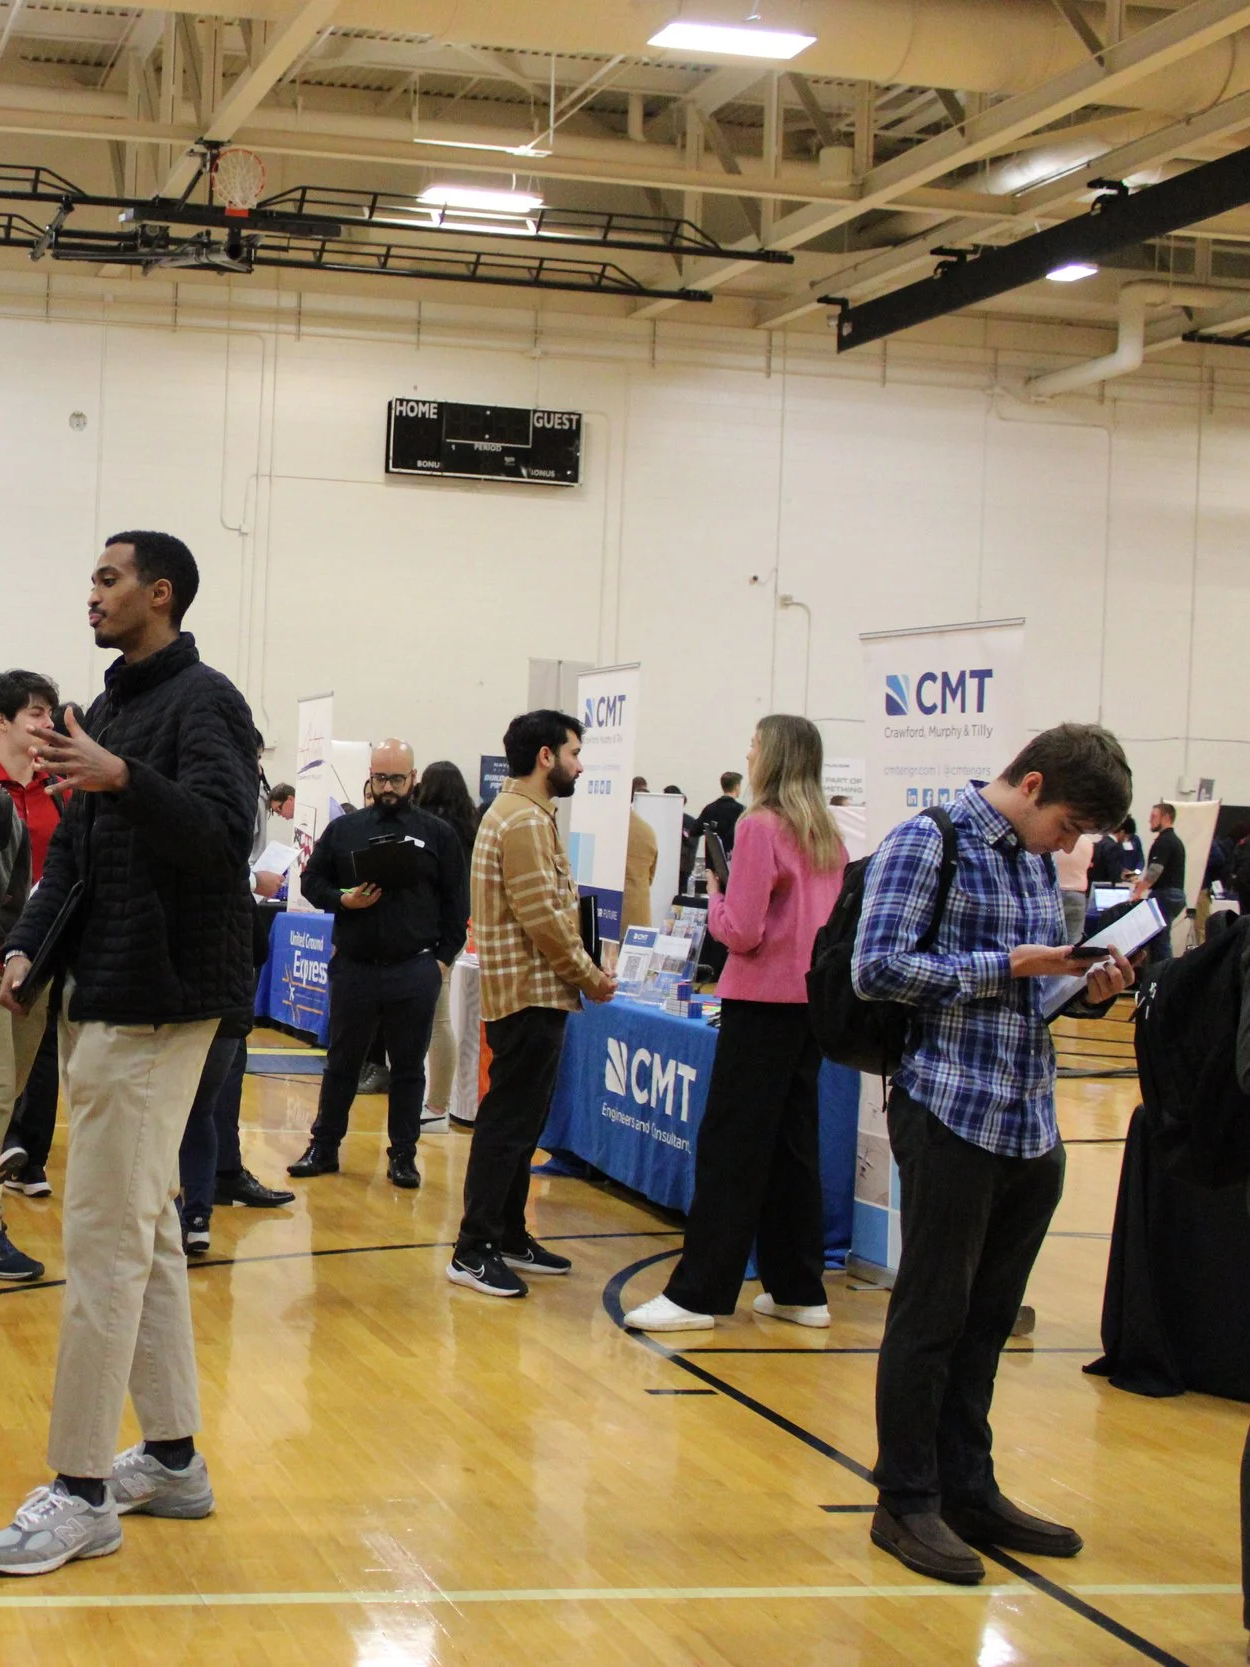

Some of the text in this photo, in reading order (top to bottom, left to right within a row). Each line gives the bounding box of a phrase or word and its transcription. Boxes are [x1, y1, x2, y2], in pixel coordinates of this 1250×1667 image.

[395, 401, 438, 419] HOME
[533, 413, 579, 430] GUEST
[473, 443, 502, 452] PERIOD
[916, 668, 993, 716] CMT
[597, 694, 626, 728] CMT
[884, 724, 994, 739] Crawford, Murphy & Tilly
[290, 929, 324, 951] United Ground
[293, 950, 328, 987] Express
[630, 1047, 697, 1122] CMT
[601, 1102, 635, 1129] Engineers
[635, 1119, 650, 1134] and
